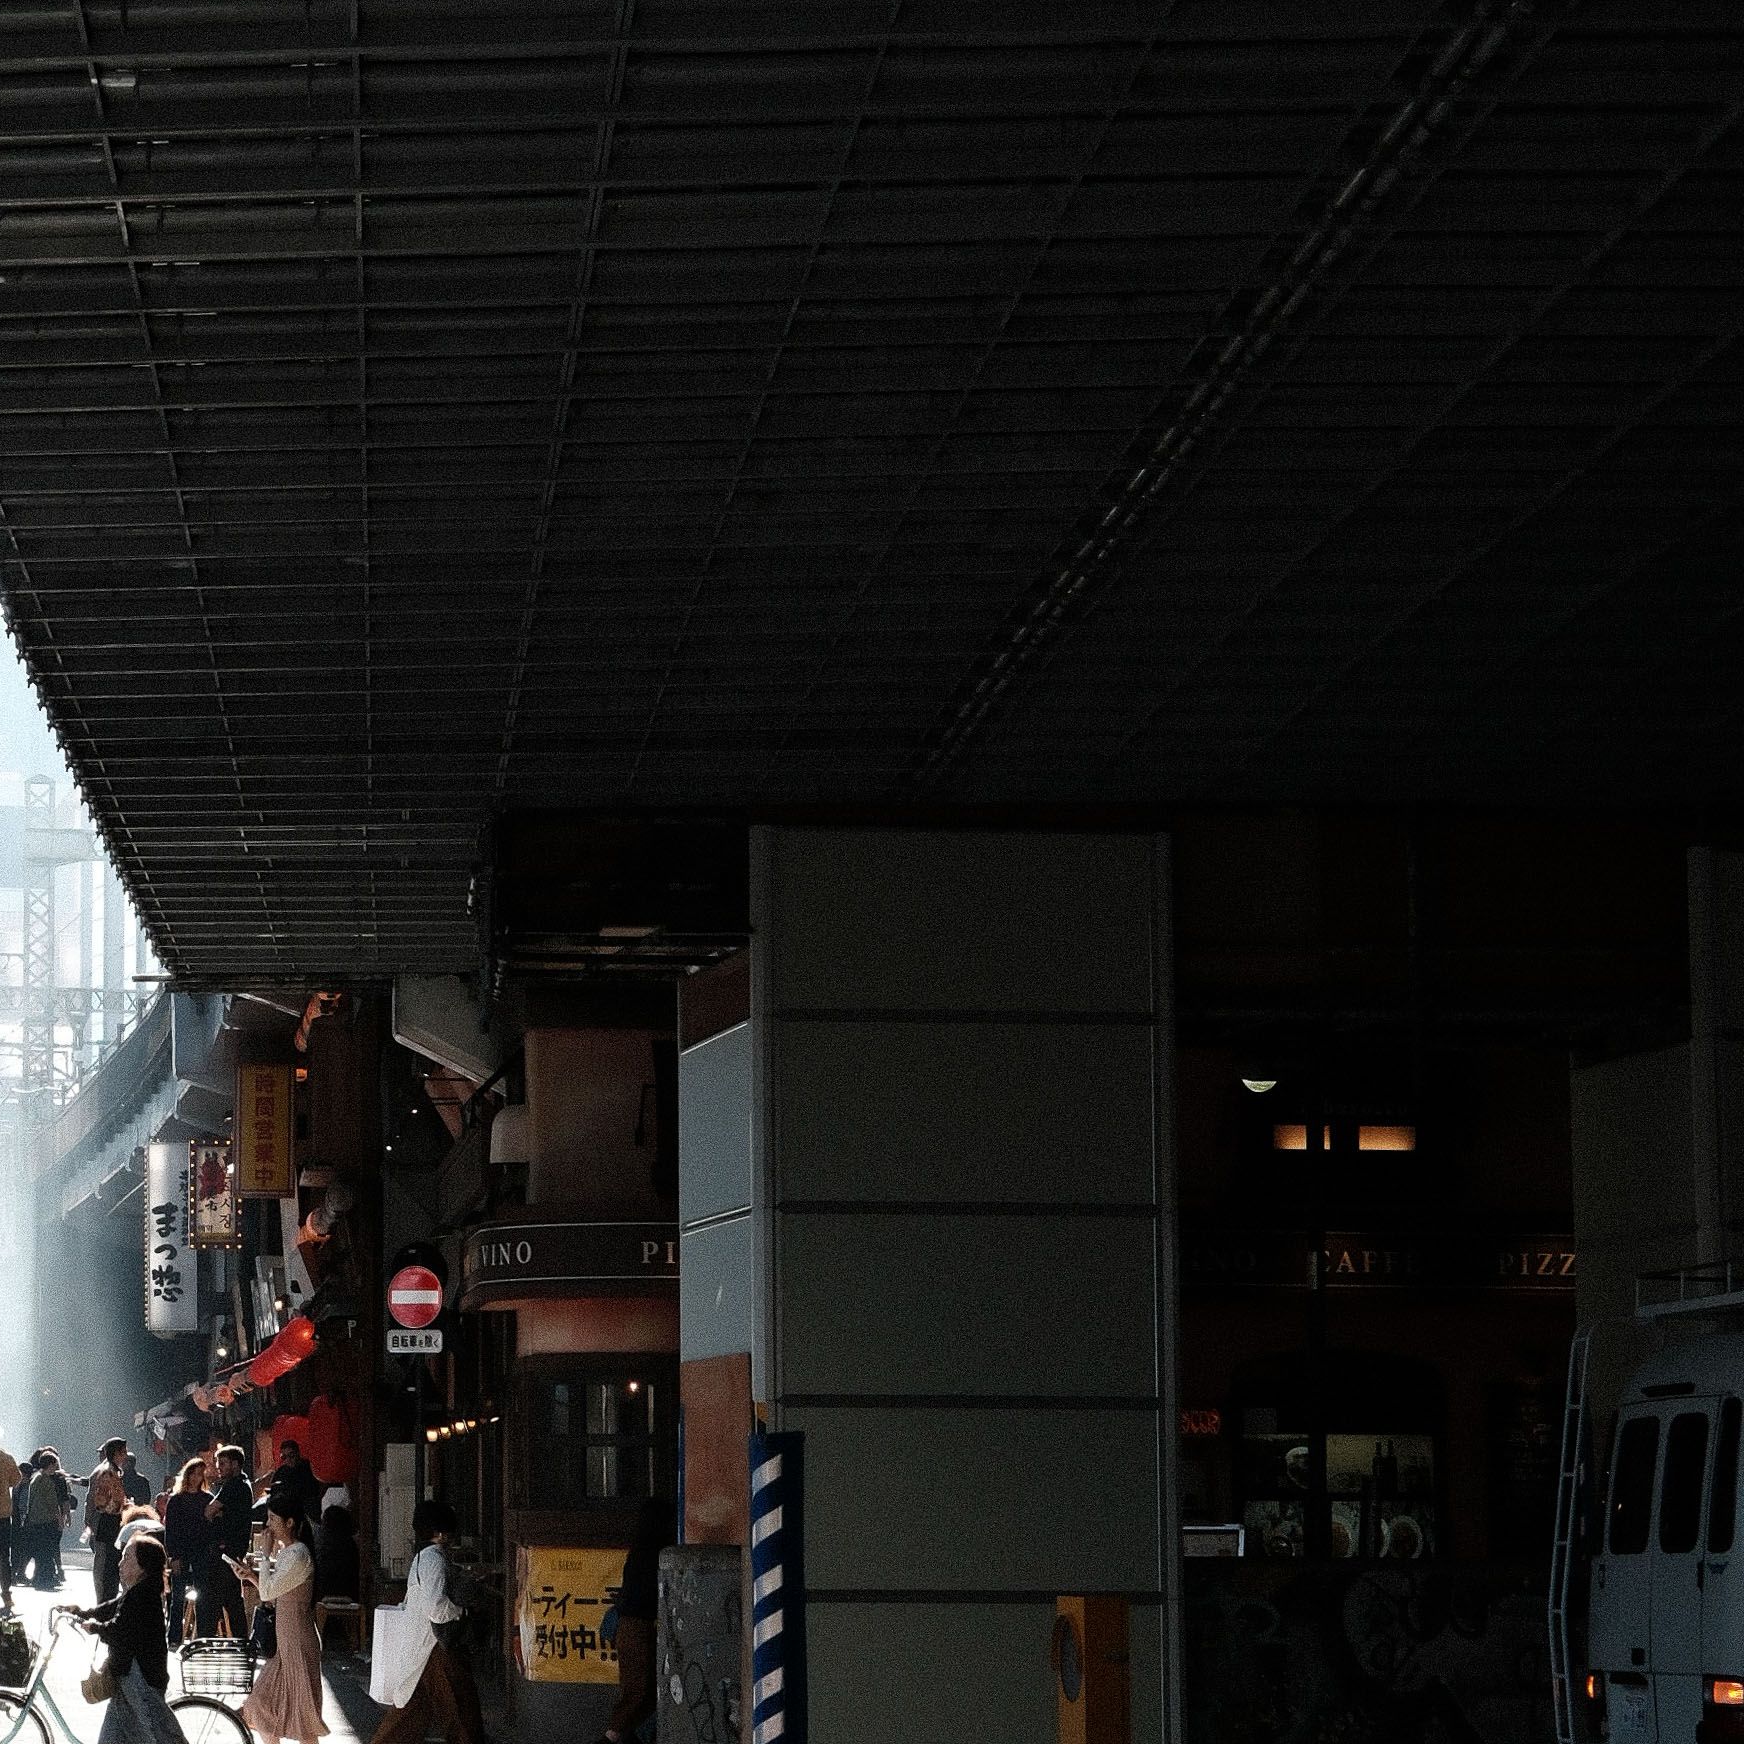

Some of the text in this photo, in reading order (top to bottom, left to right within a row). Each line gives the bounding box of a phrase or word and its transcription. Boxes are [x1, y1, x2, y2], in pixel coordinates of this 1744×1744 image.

[480, 1241, 533, 1267] VINO
[392, 1334, 440, 1348] 自転車を除く
